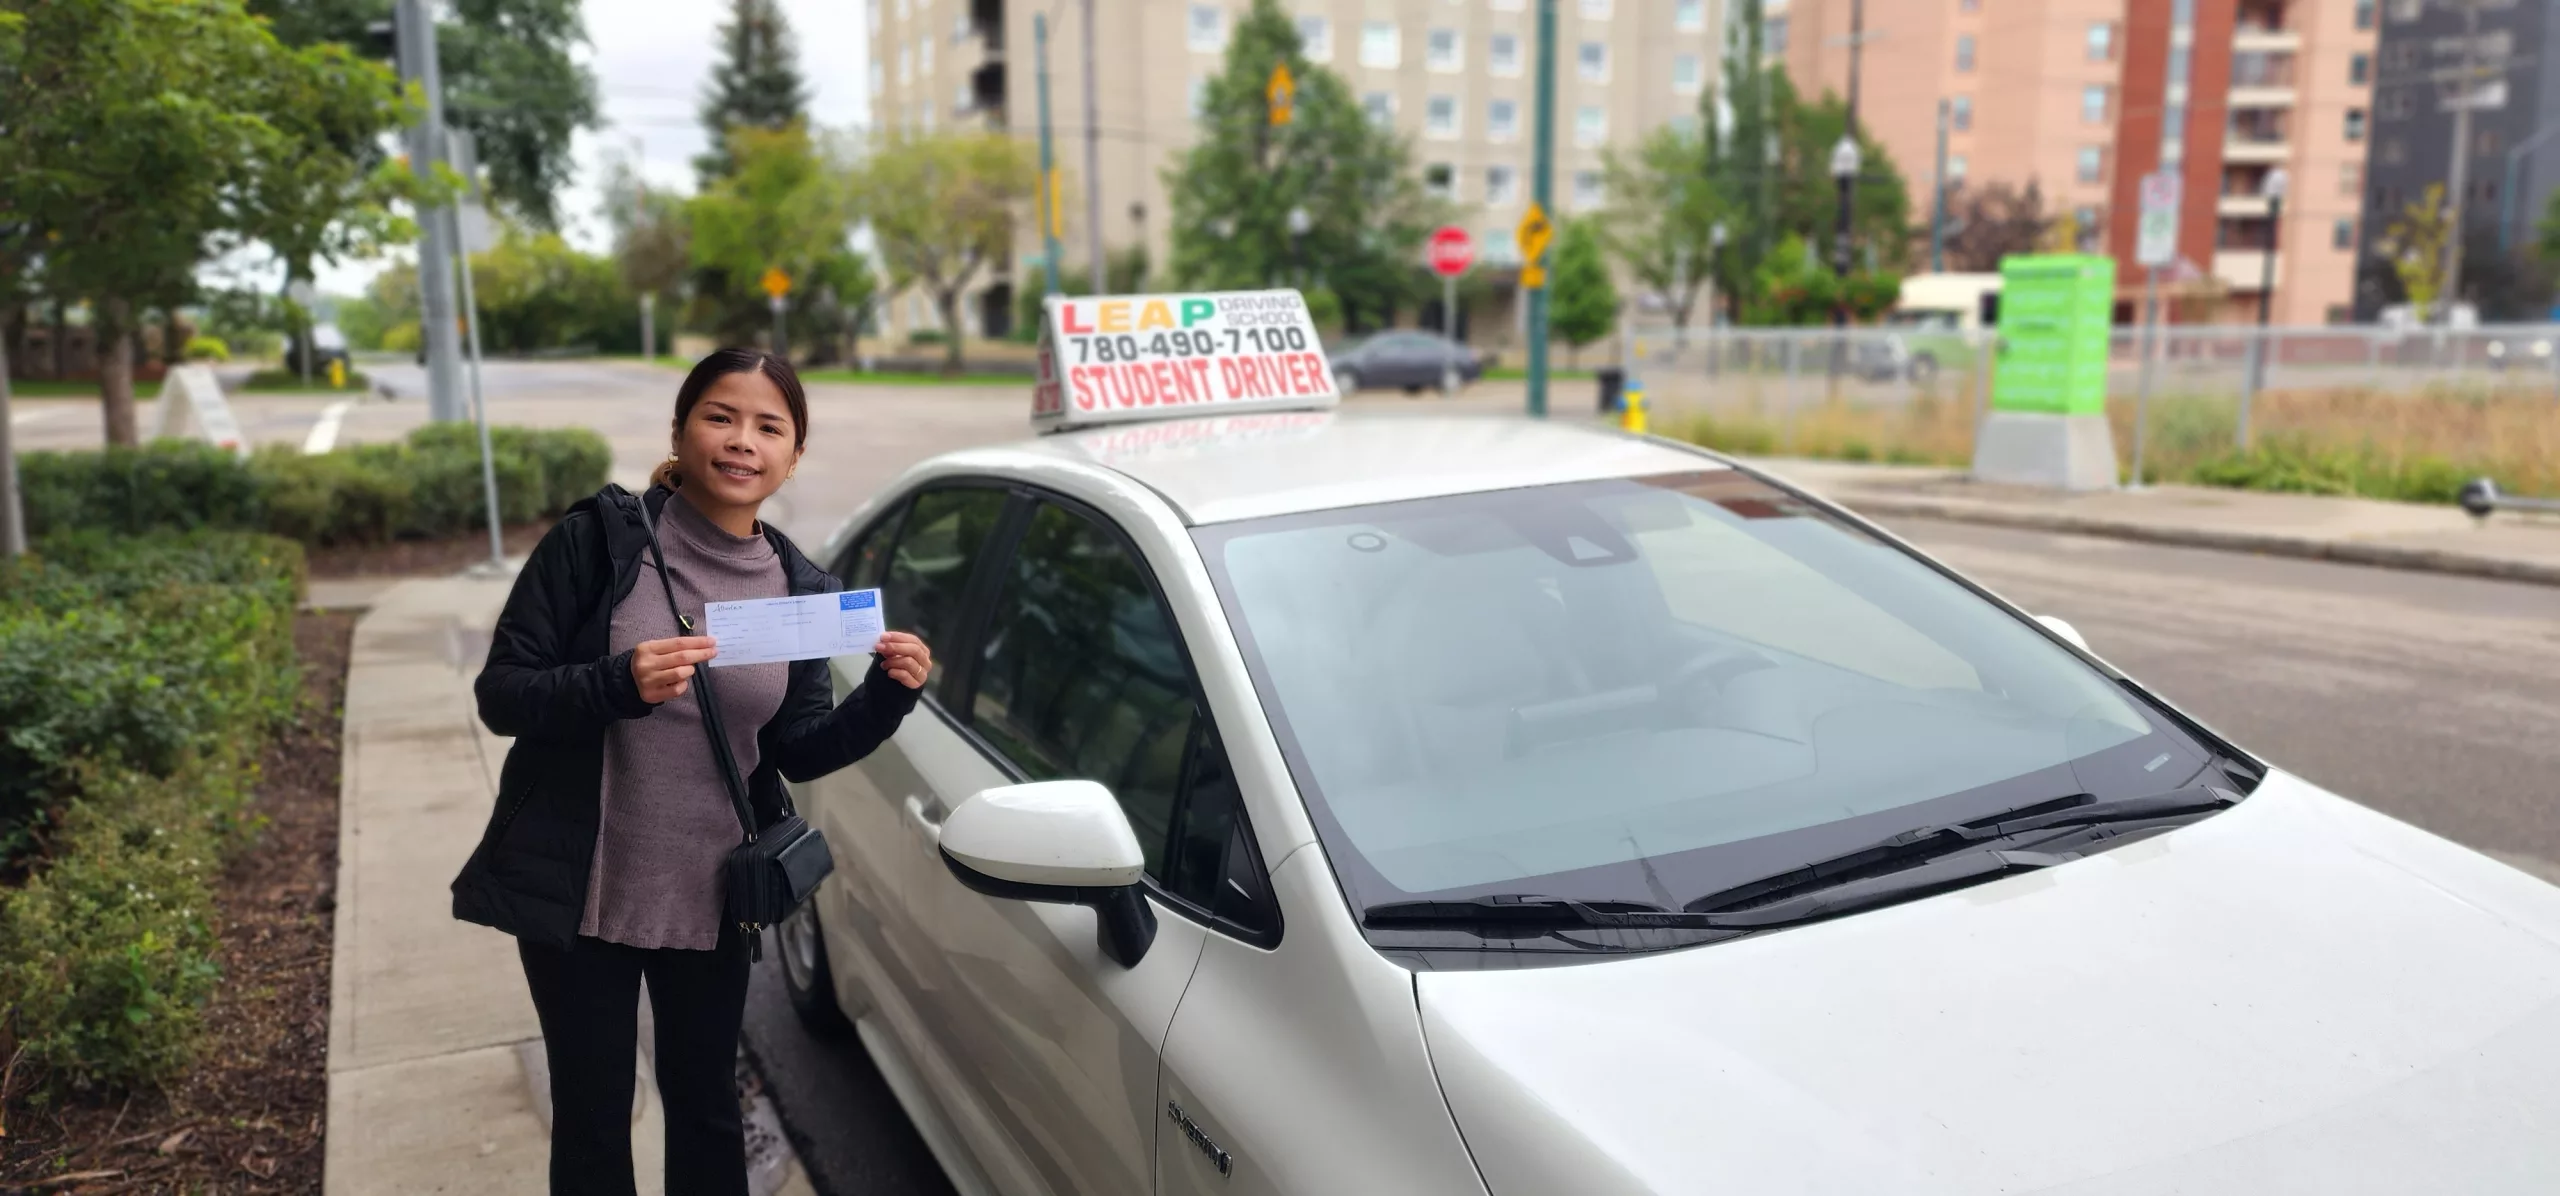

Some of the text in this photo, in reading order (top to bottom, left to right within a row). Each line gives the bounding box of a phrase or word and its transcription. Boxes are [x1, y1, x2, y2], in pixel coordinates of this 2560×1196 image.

[1061, 299, 1216, 335] LEAP
[1219, 296, 1302, 312] DRIVING
[1226, 311, 1303, 327] SCHOOL
[1070, 326, 1307, 363] 780-490-7100
[1070, 358, 1214, 411] STUDENT
[1219, 352, 1330, 401] DRIVER
